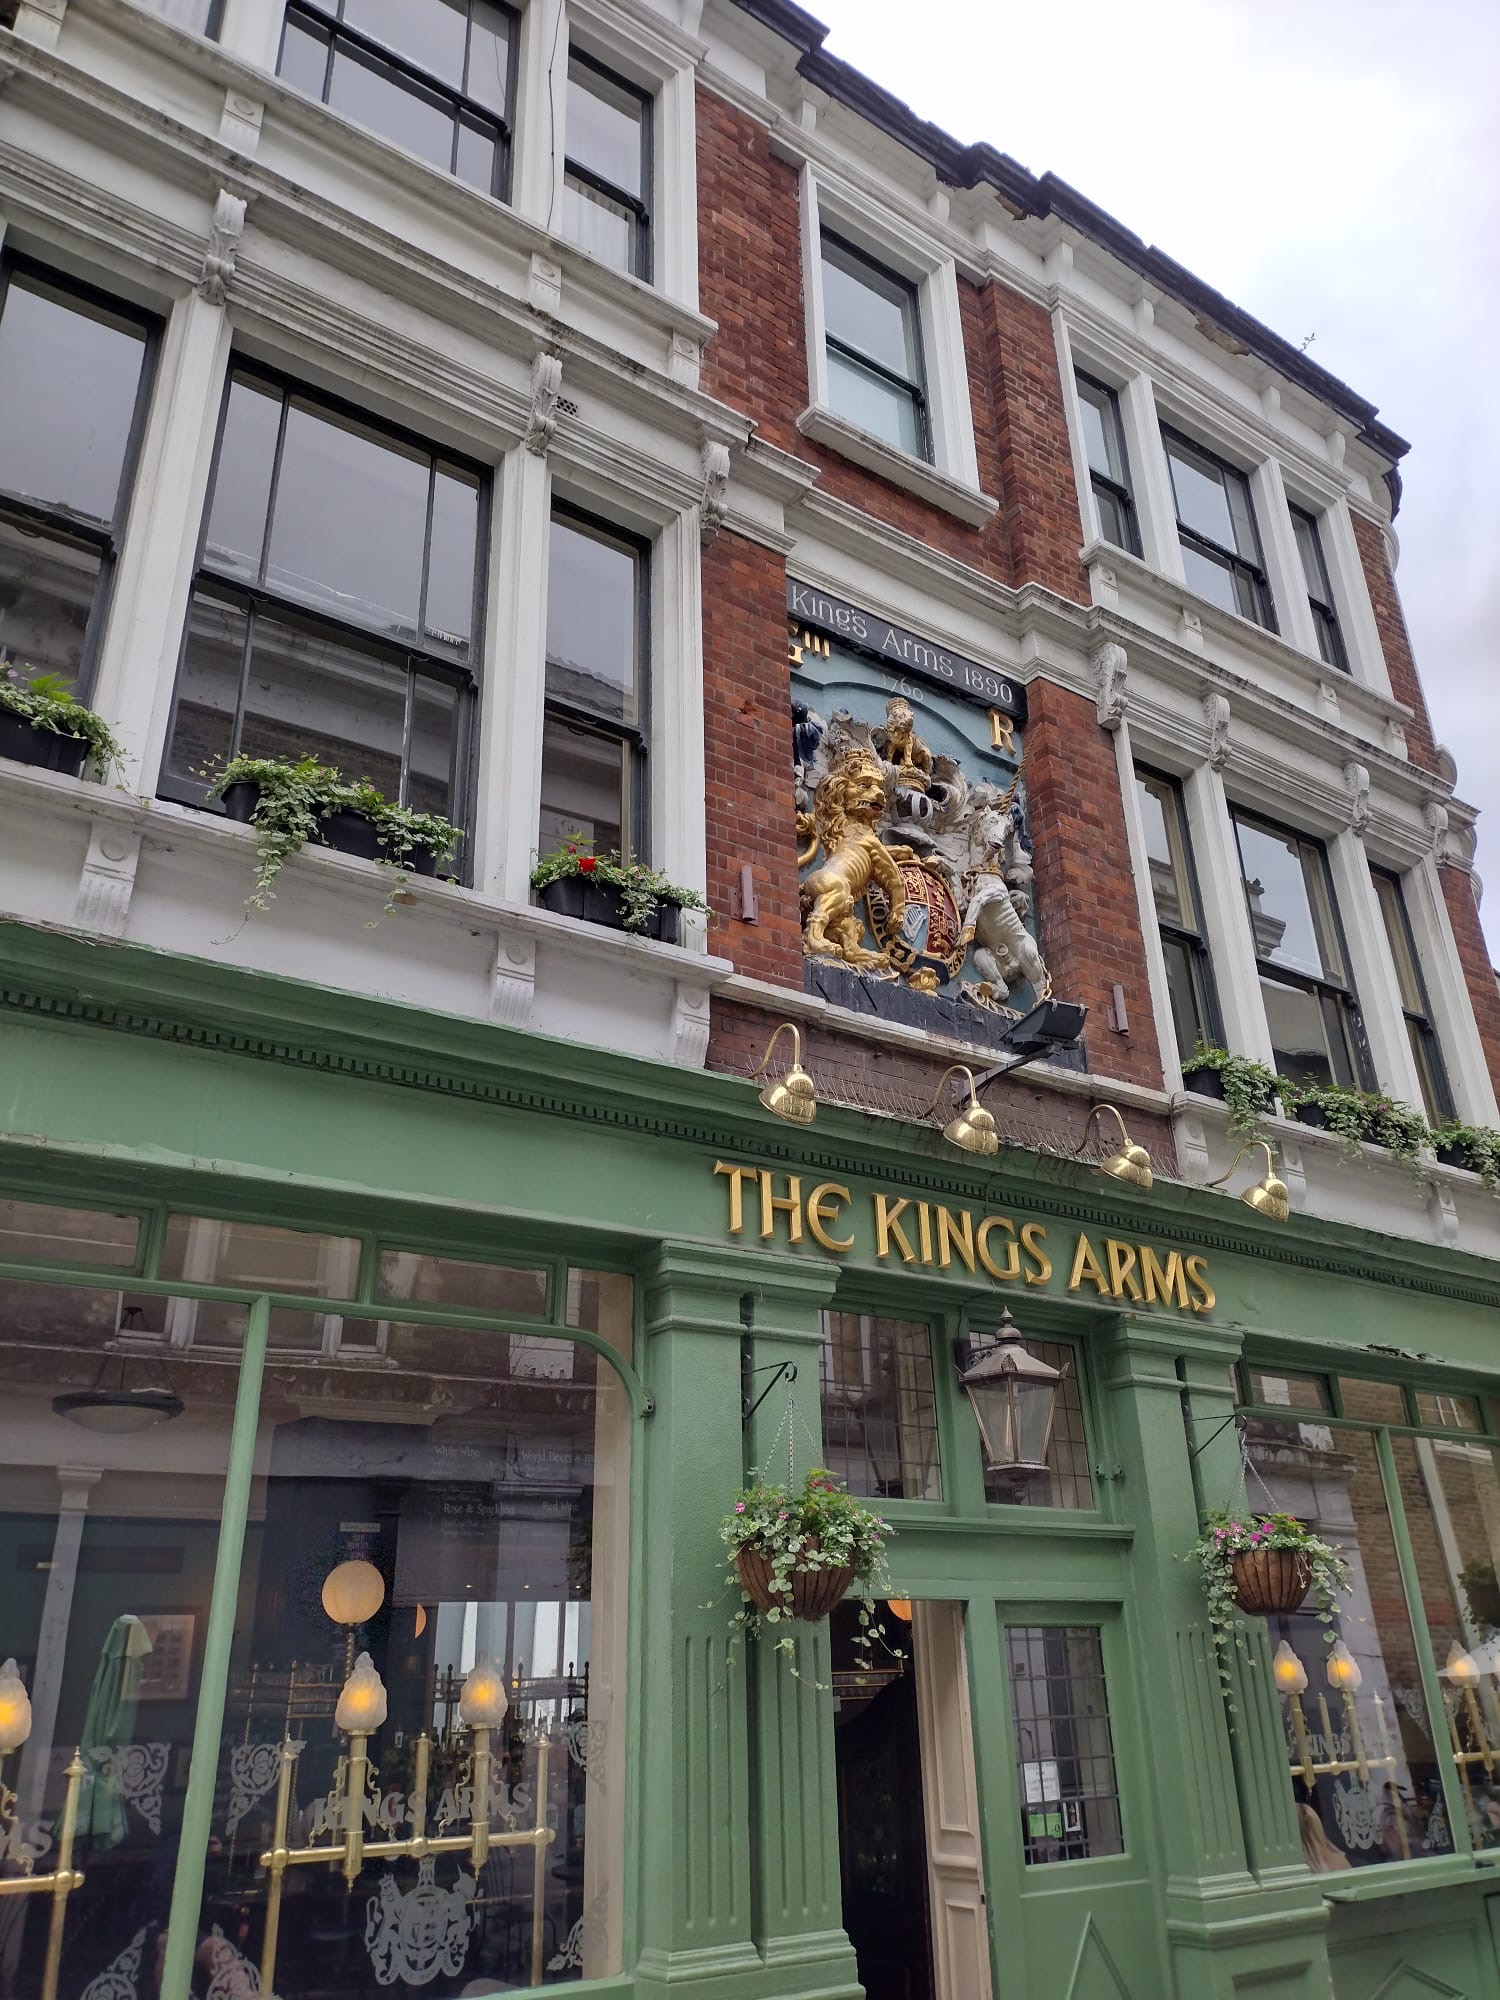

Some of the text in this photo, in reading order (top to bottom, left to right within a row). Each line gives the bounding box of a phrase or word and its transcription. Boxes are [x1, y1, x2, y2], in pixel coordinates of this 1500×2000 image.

[791, 585, 1013, 703] King's Arms 1890
[881, 673, 924, 701] 1760
[986, 707, 1016, 757] R
[713, 1159, 1216, 1313] THE KINGS ARMS
